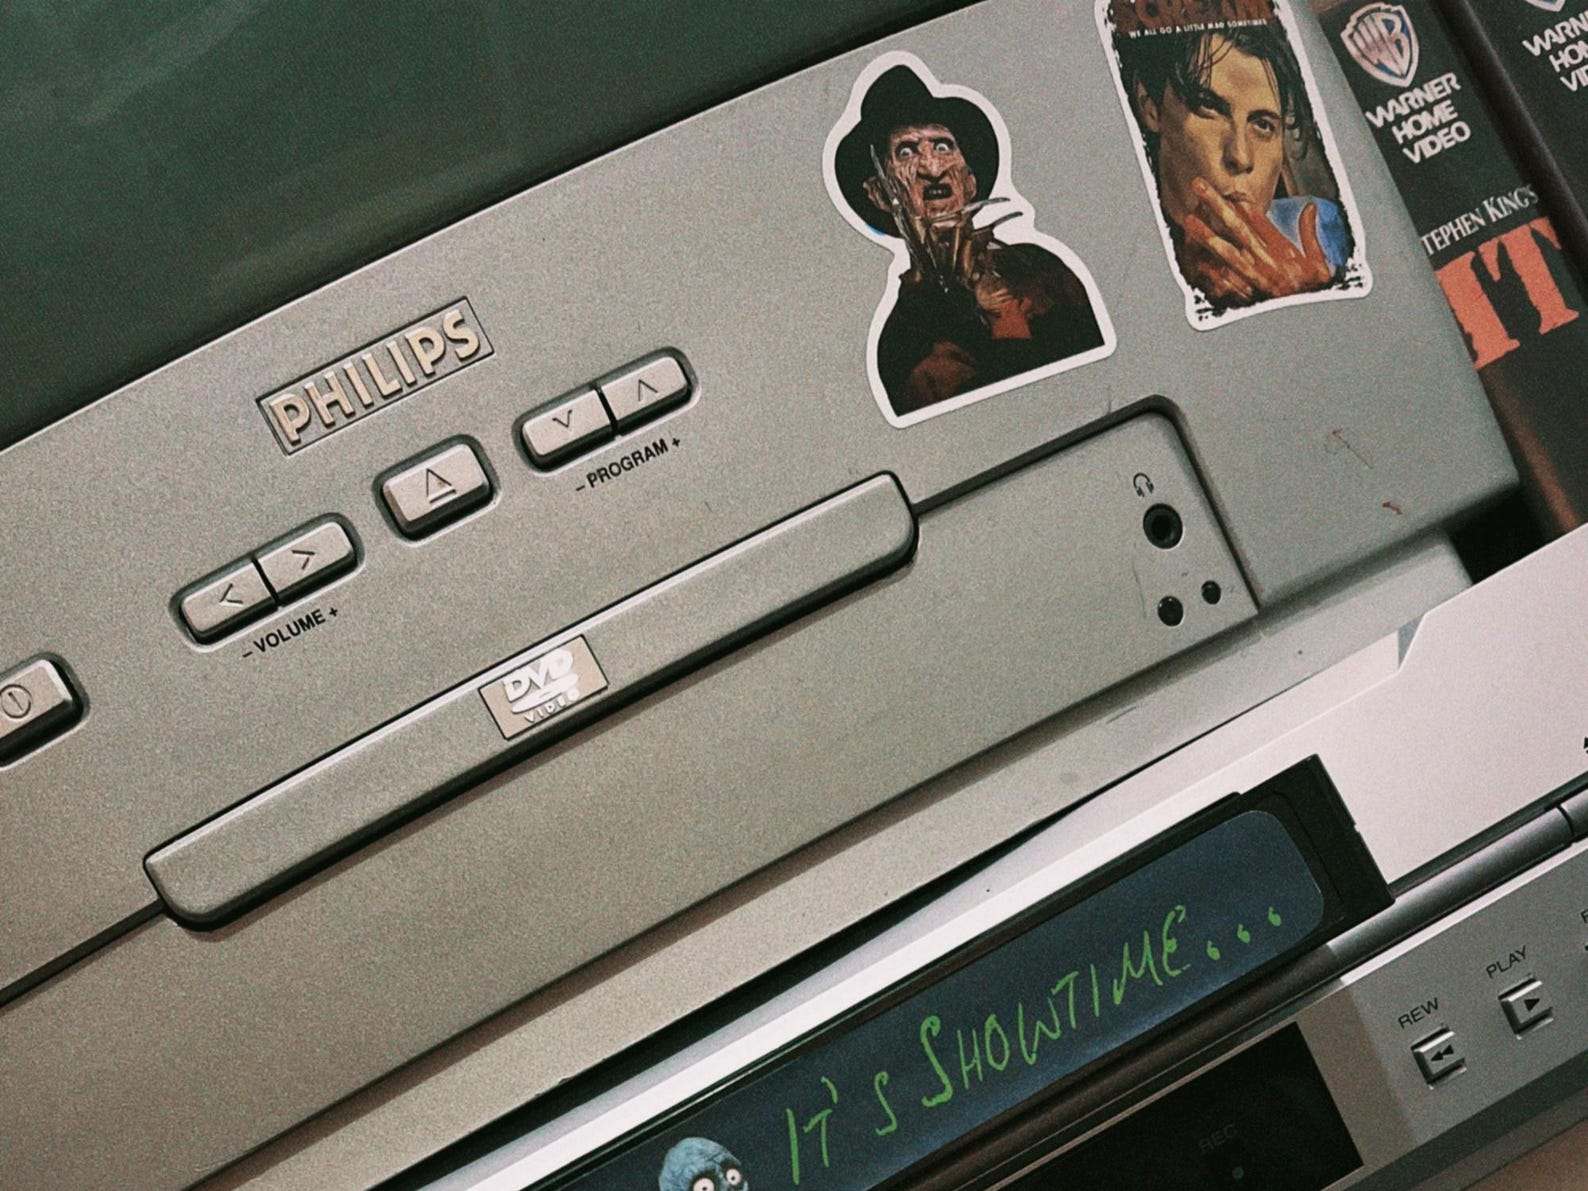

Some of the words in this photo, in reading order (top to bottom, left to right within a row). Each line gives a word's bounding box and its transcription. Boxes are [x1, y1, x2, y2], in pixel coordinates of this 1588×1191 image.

[1159, 26, 1173, 35] GO
[1522, 10, 1588, 57] WARN
[1365, 72, 1462, 128] WARNER
[1391, 100, 1458, 144] HOME
[1402, 121, 1471, 164] VIDEO
[1421, 208, 1486, 255] TEPHEN
[1433, 216, 1579, 371] IT
[269, 308, 482, 447] PHILIPS
[586, 438, 669, 488] PROGRAM
[253, 608, 326, 652] VOLUME
[503, 648, 574, 704] DVD
[1486, 945, 1527, 979] PLAY
[1398, 997, 1439, 1029] REW
[786, 1071, 898, 1184] IT'S
